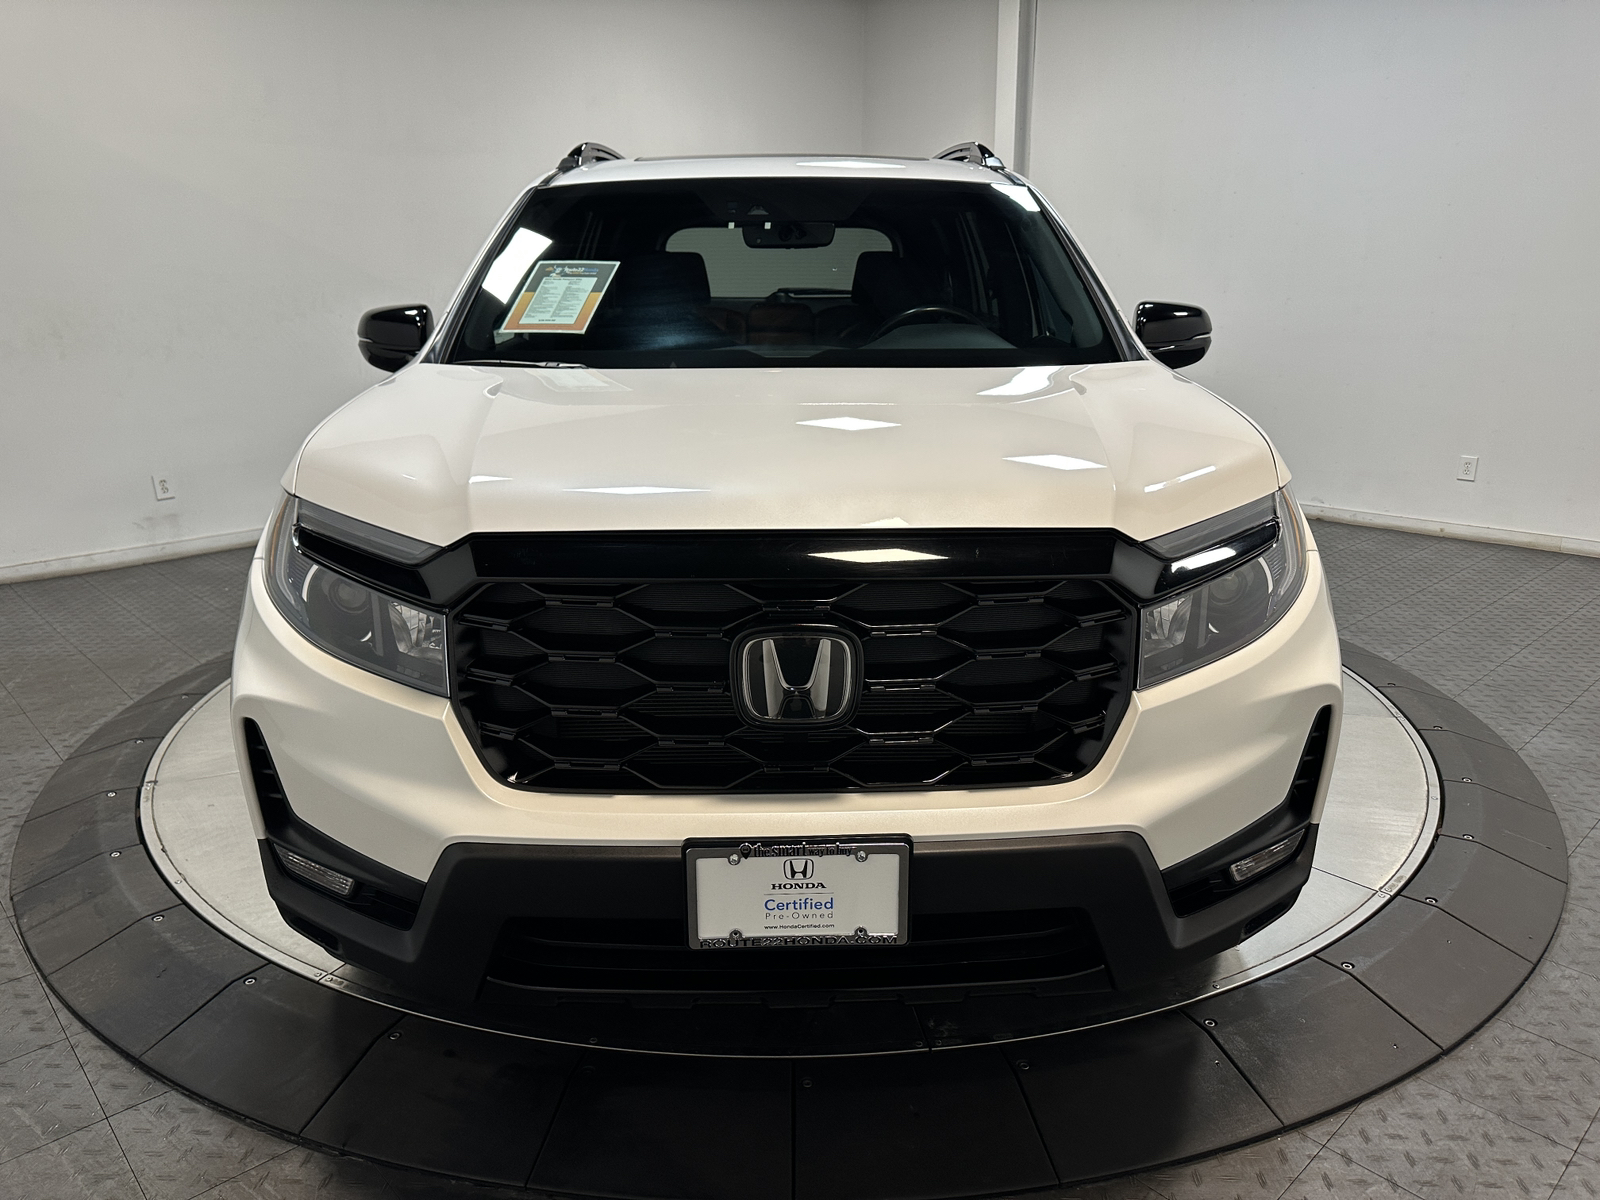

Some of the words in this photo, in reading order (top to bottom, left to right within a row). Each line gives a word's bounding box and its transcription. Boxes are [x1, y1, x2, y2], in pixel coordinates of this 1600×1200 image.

[754, 843, 770, 857] the
[772, 842, 806, 857] smart
[808, 847, 824, 857] way
[826, 845, 835, 855] to
[836, 843, 852, 857] buy
[771, 882, 827, 890] HONDA
[764, 897, 834, 911] Certified
[765, 911, 834, 920] Pre-Owned
[699, 935, 897, 948] ROUTE22HONDA.COM
